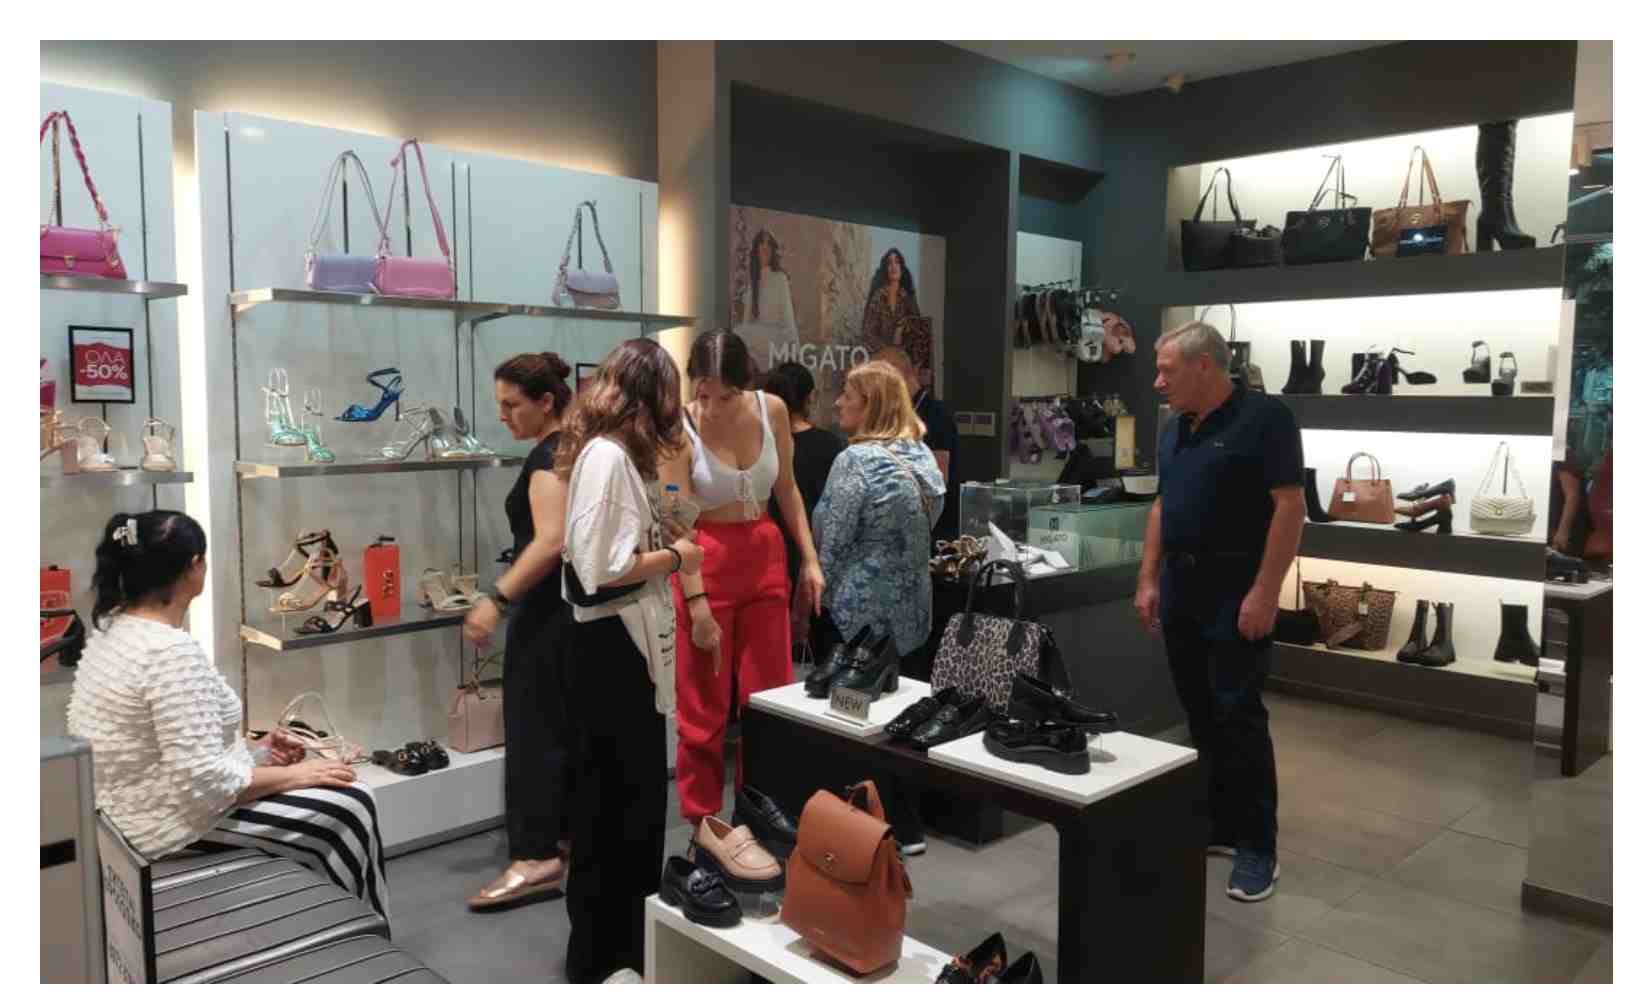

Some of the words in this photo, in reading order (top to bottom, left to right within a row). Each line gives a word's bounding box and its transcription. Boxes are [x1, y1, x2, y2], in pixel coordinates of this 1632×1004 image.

[767, 341, 870, 370] MIGATO
[80, 363, 129, 380] -50%
[835, 694, 864, 713] NEW
